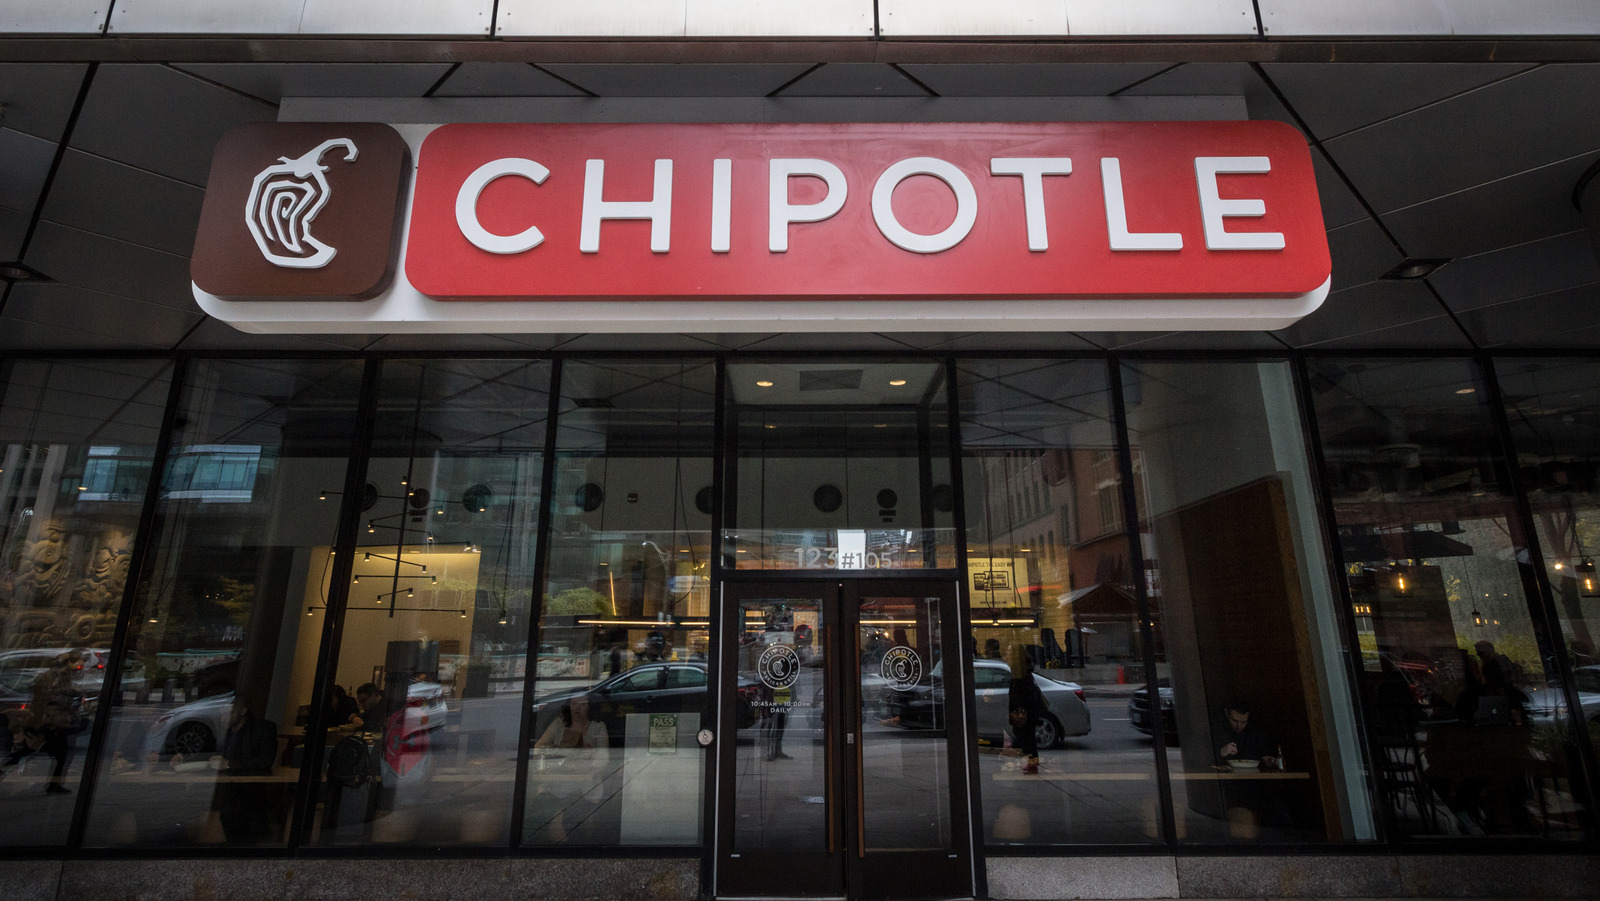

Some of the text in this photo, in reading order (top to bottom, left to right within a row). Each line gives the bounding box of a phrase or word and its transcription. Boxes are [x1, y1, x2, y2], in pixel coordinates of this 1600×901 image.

[455, 156, 1286, 254] CHIPOTLE
[794, 547, 893, 569] 123 #105
[762, 648, 797, 664] CHIPOTLE
[884, 649, 919, 666] CHIPOTLE
[653, 717, 674, 727] PASS
